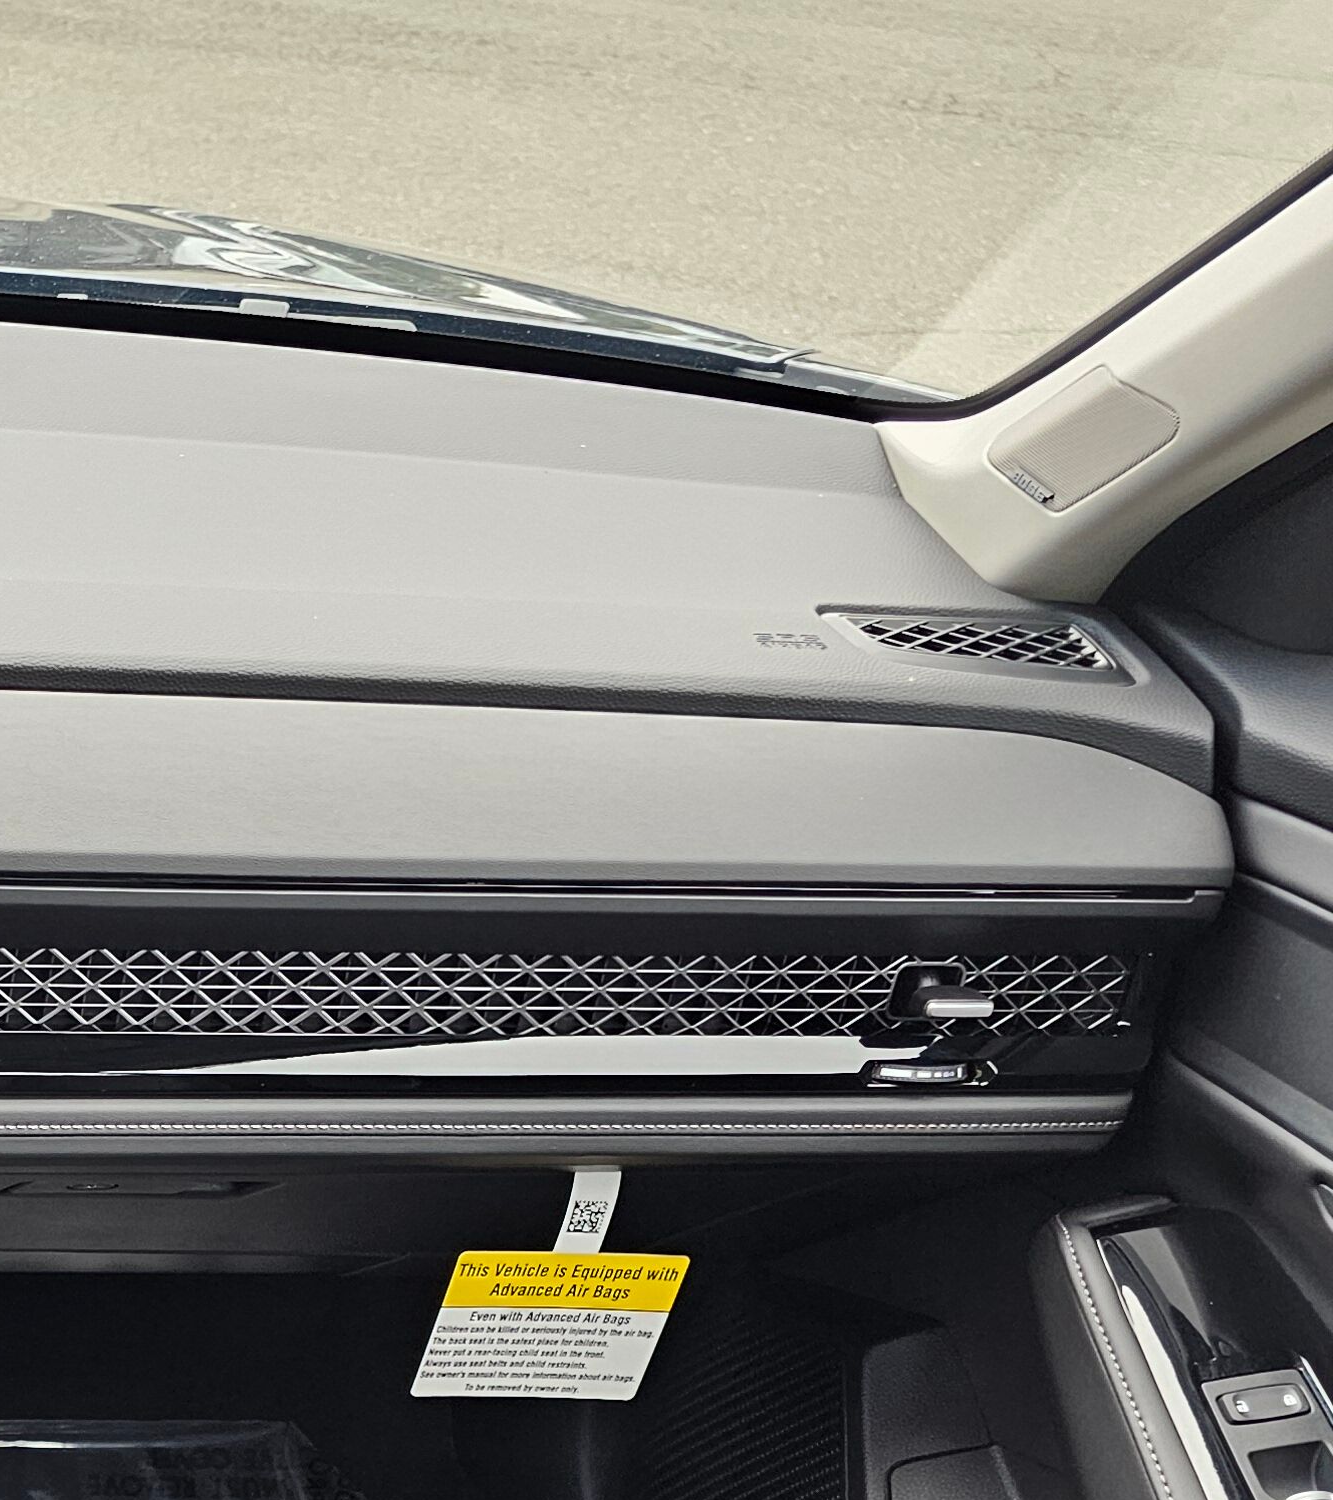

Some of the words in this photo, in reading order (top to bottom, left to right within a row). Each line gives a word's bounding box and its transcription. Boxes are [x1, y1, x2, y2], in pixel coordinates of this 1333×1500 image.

[459, 1263, 490, 1278] This
[495, 1263, 550, 1278] Vehicle
[553, 1264, 568, 1278] is
[571, 1264, 644, 1282] Equipped
[646, 1267, 679, 1282] with
[489, 1283, 564, 1297] Advanced
[565, 1284, 590, 1298] Air
[592, 1284, 631, 1302] Bags
[469, 1311, 497, 1322] Even
[499, 1311, 523, 1322] with
[524, 1311, 582, 1323] Advanced
[582, 1312, 601, 1324] Air
[602, 1313, 632, 1327] Bags
[486, 1383, 523, 1392] removed
